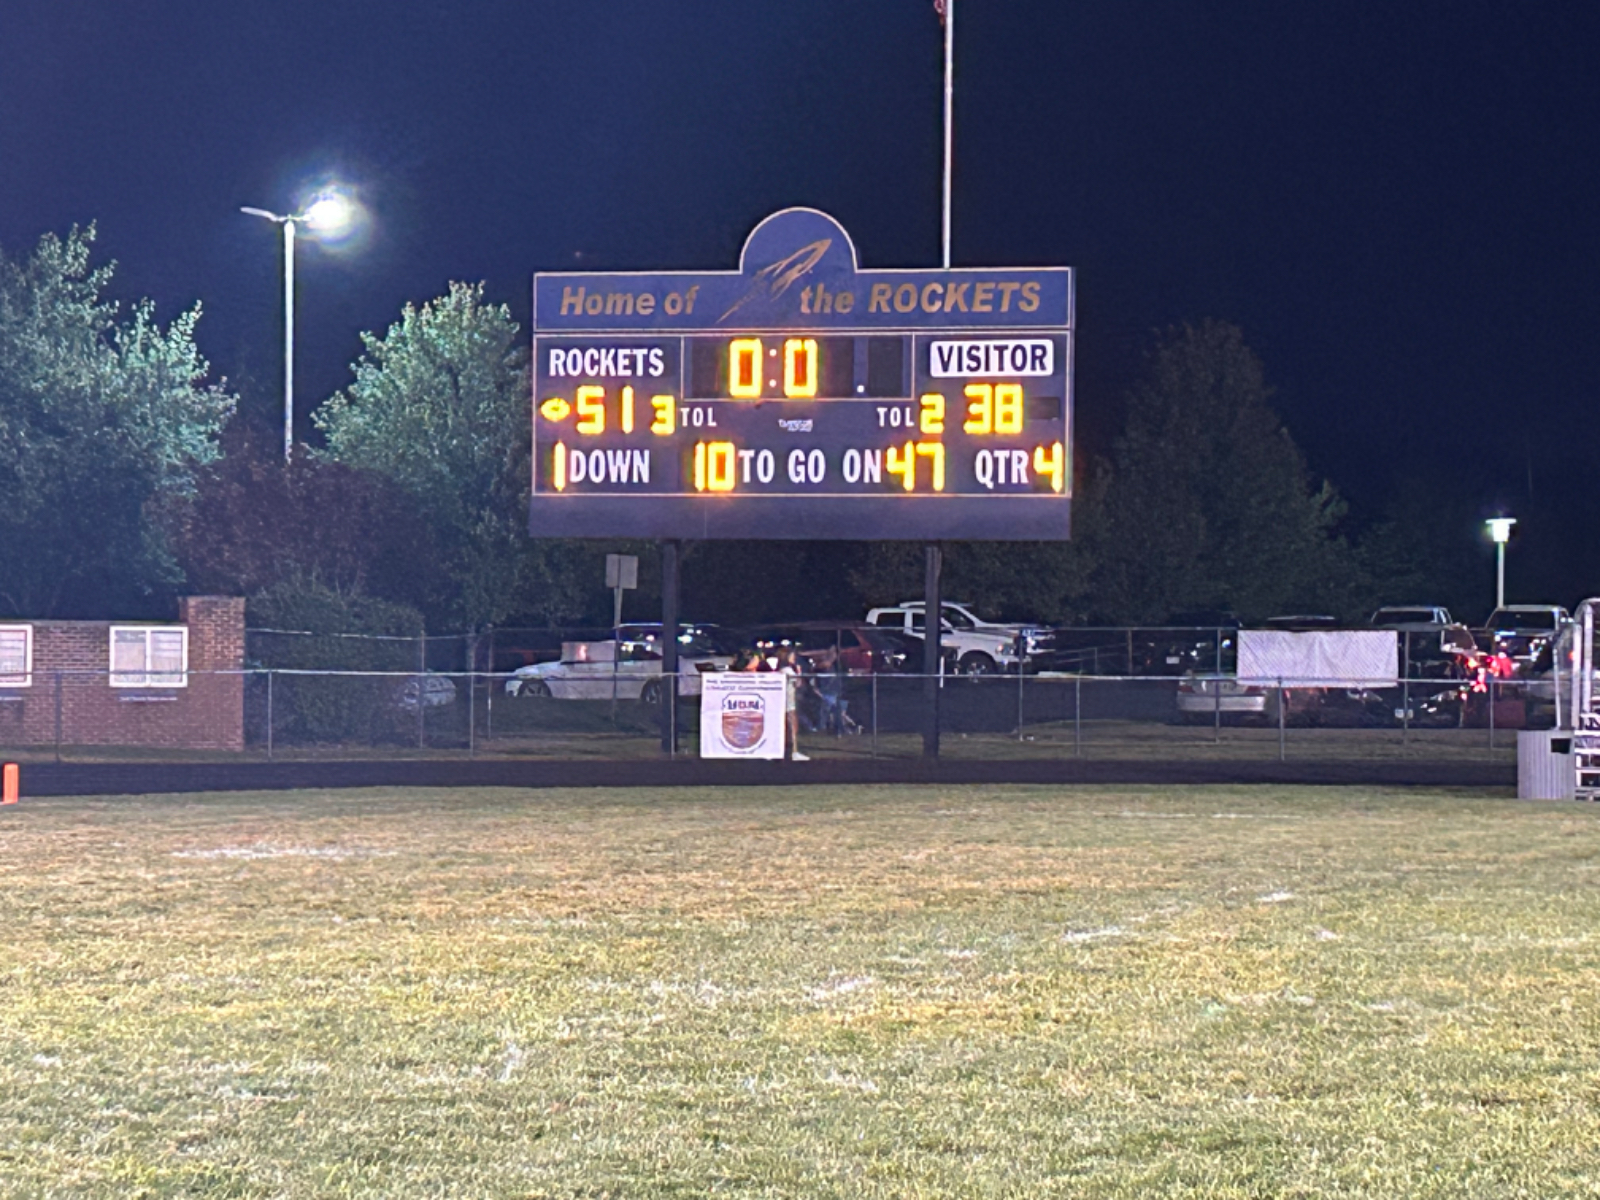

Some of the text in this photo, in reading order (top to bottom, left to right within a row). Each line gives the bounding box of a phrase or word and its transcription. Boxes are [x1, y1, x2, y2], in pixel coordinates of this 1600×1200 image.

[560, 281, 1042, 316] Home of the ROCKETS
[549, 348, 665, 377] ROCKETS
[937, 343, 1048, 373] VISITOR
[651, 395, 676, 436] 3
[680, 407, 718, 427] TOL
[877, 407, 915, 427] TOL
[920, 394, 946, 434] 2
[963, 383, 1024, 435] 38
[553, 440, 566, 492] 1
[569, 449, 651, 483] DOWN
[694, 441, 736, 492] 10
[738, 449, 882, 483] TO GO ON
[886, 440, 945, 492] 47
[975, 449, 1029, 489] QTR
[1034, 439, 1063, 492] 4
